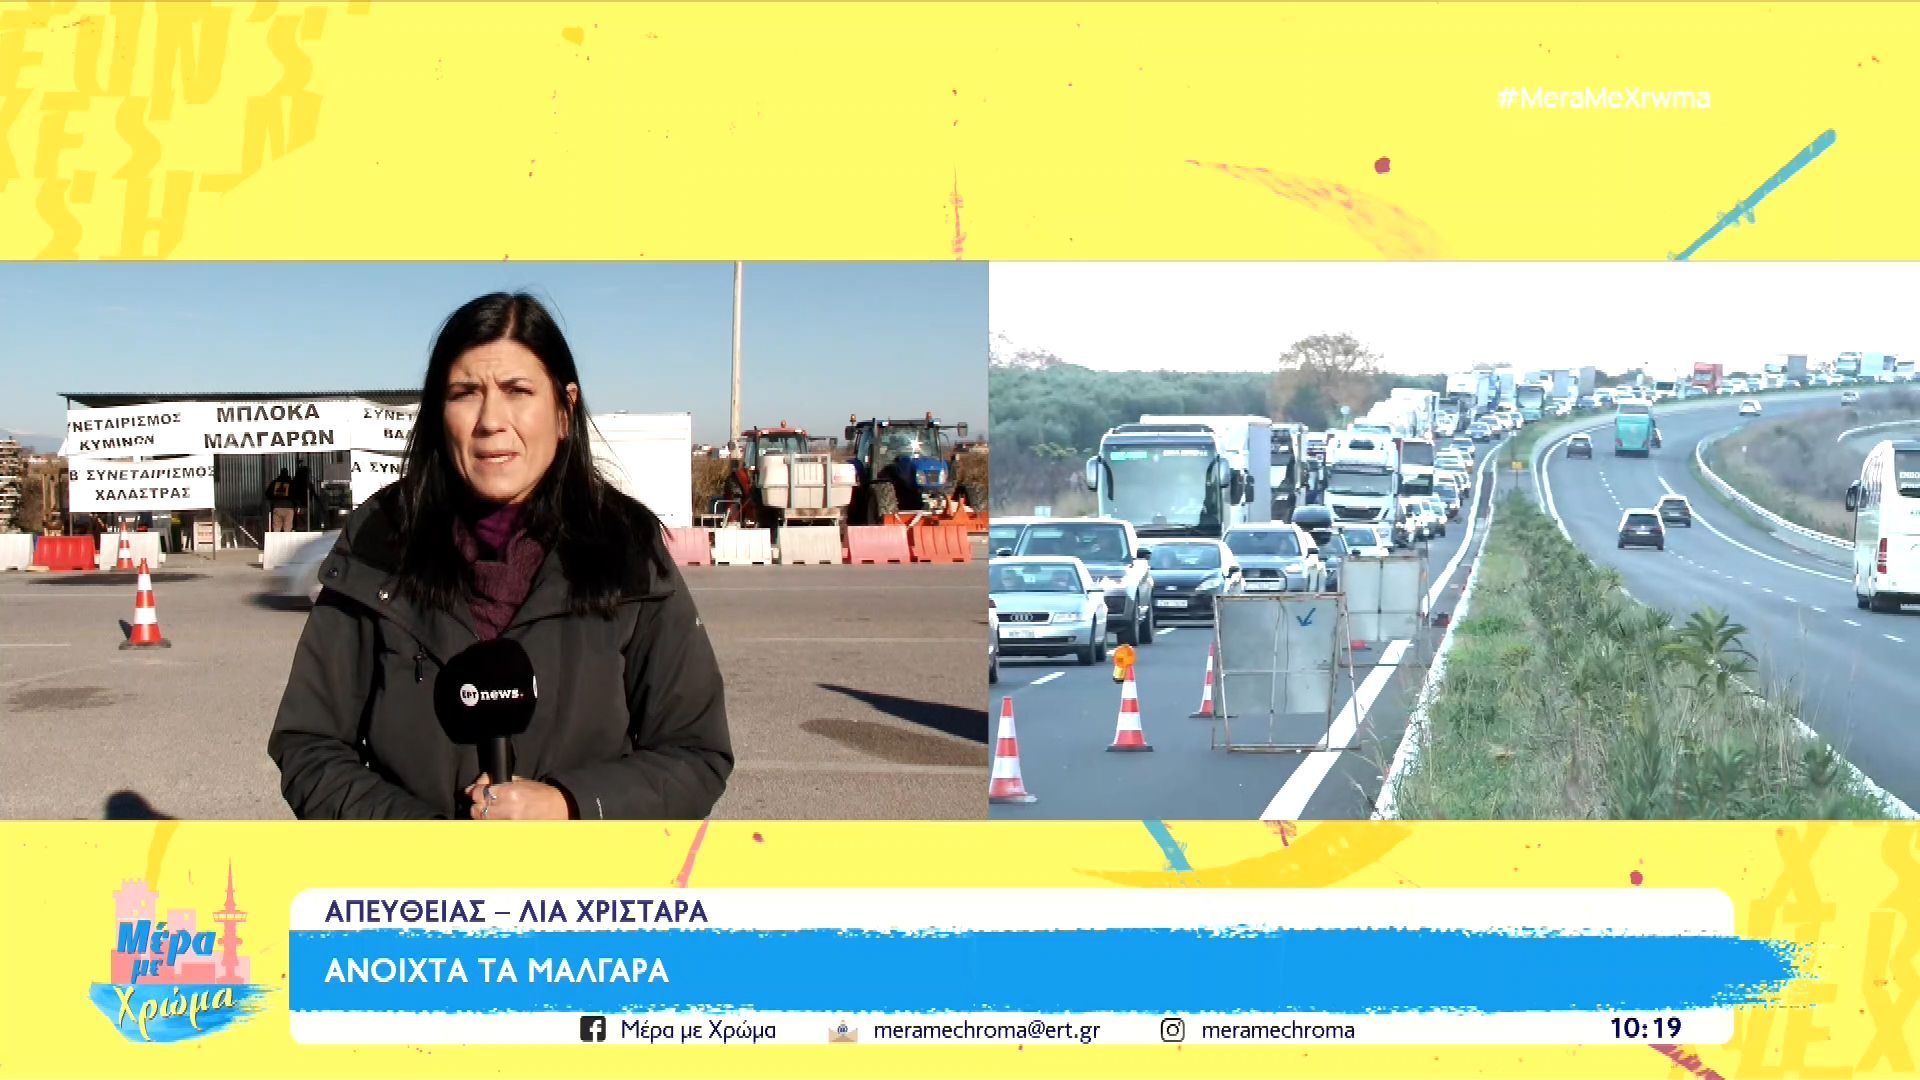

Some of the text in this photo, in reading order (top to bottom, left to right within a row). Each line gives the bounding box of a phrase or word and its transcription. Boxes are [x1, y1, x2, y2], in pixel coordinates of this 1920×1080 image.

[217, 403, 320, 422] ΜΠΛΟΚΑ
[364, 408, 415, 420] ΣΥΝΕΤ
[80, 434, 154, 451] ΚΥΜΙΝΩΝ
[204, 429, 334, 448] ΜΑΛΓΑΡΩΝ
[87, 466, 215, 480] ΣΥΝΕΤΑΙΡΙΣΜΟΣ
[370, 462, 401, 474] ΣΥΝ
[96, 487, 190, 500] ΧΑΛΑΣΤΡΑΣ
